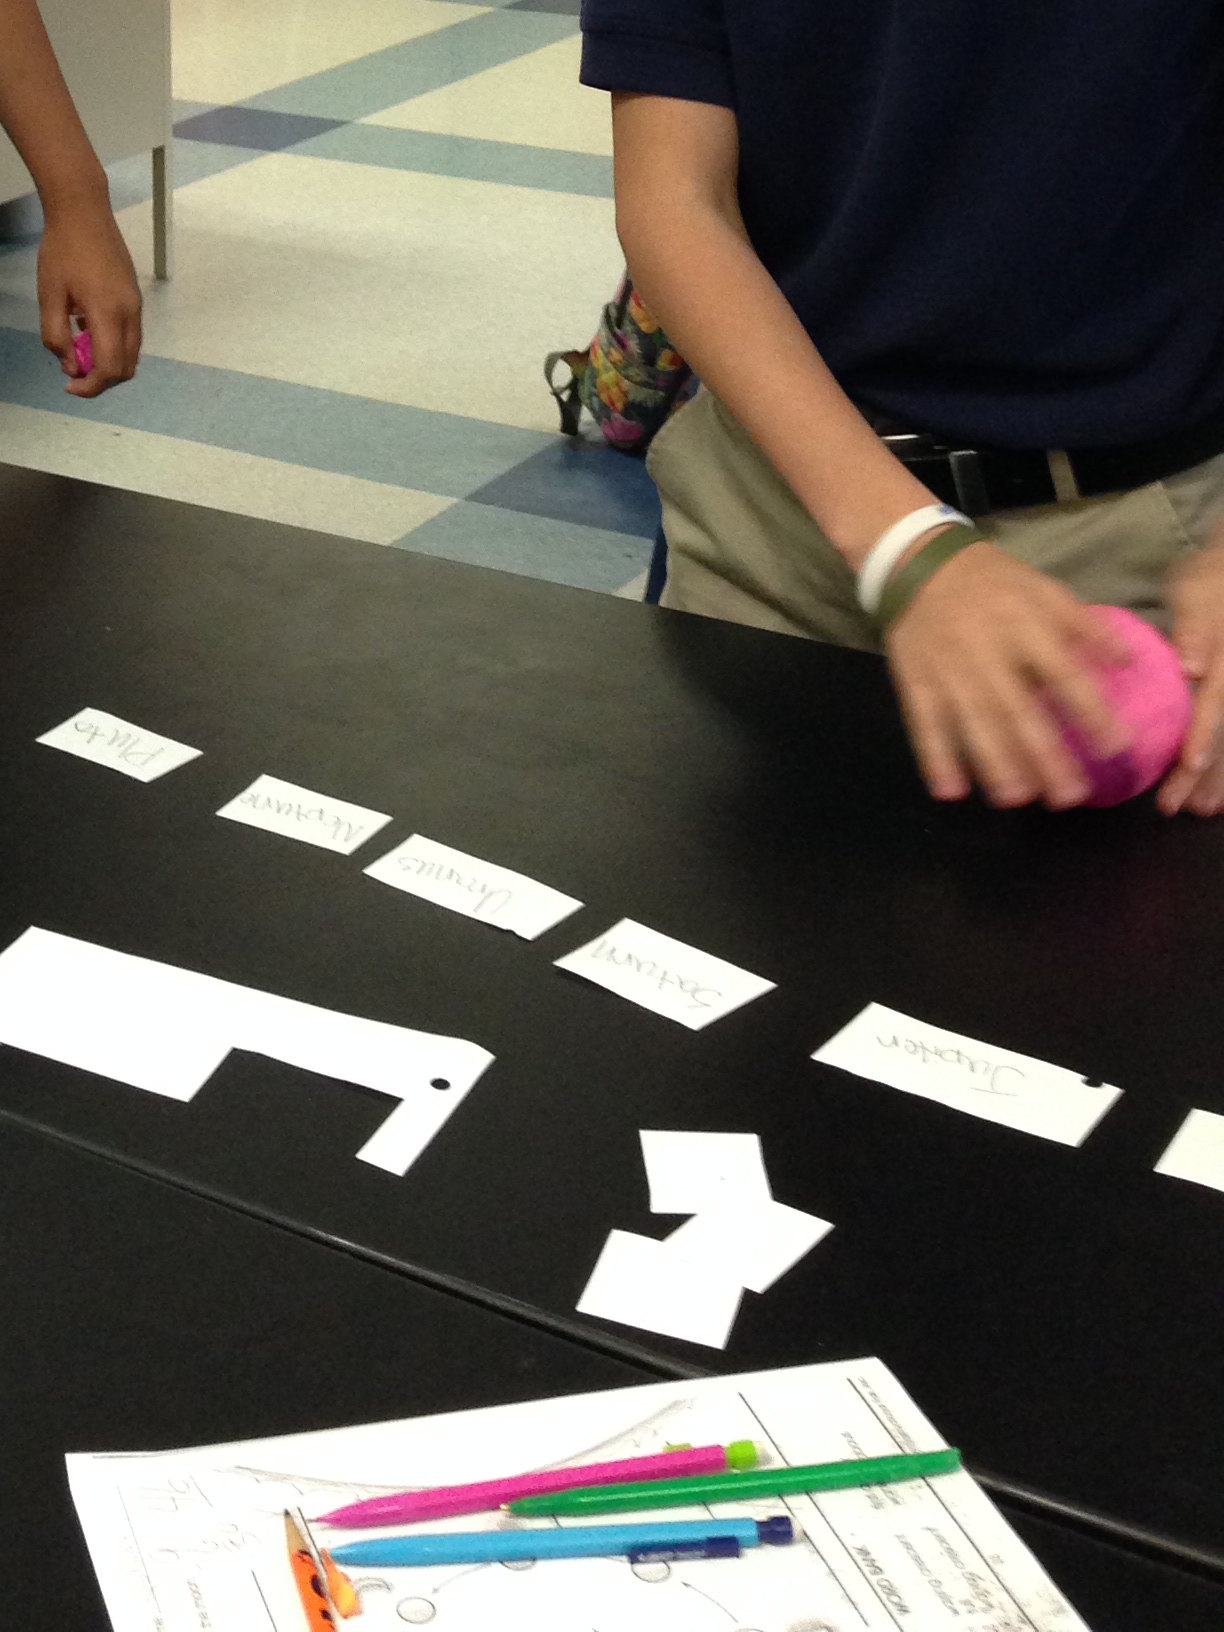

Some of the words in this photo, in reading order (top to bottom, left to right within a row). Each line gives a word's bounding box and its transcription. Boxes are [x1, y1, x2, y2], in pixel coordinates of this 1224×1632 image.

[73, 719, 166, 767] Pluto
[239, 792, 365, 843] Neptune
[590, 938, 723, 1010] Saturn
[875, 1033, 1026, 1097] Jupiter
[852, 1544, 885, 1576] BANK
[876, 1577, 911, 1616] WORD
